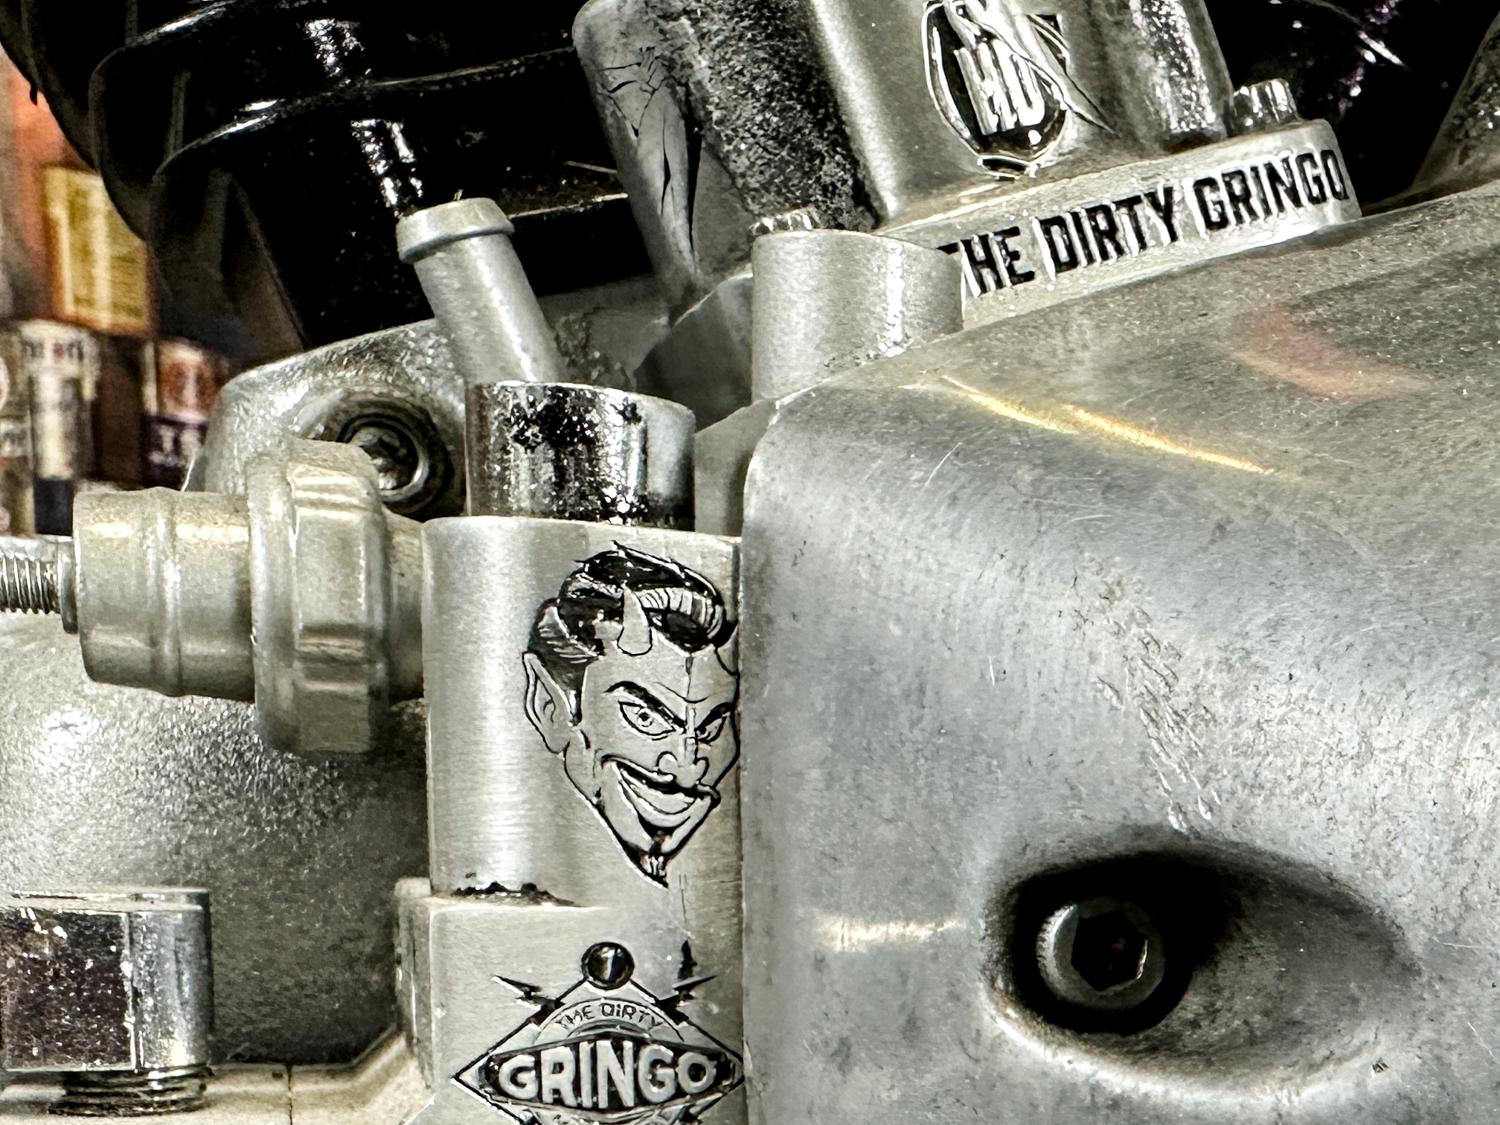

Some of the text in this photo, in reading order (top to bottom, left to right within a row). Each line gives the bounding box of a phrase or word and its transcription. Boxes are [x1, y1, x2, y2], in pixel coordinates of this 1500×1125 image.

[1034, 185, 1178, 281] DIRTY
[1190, 149, 1350, 232] GRINGO
[498, 1039, 717, 1109] GRINGO
